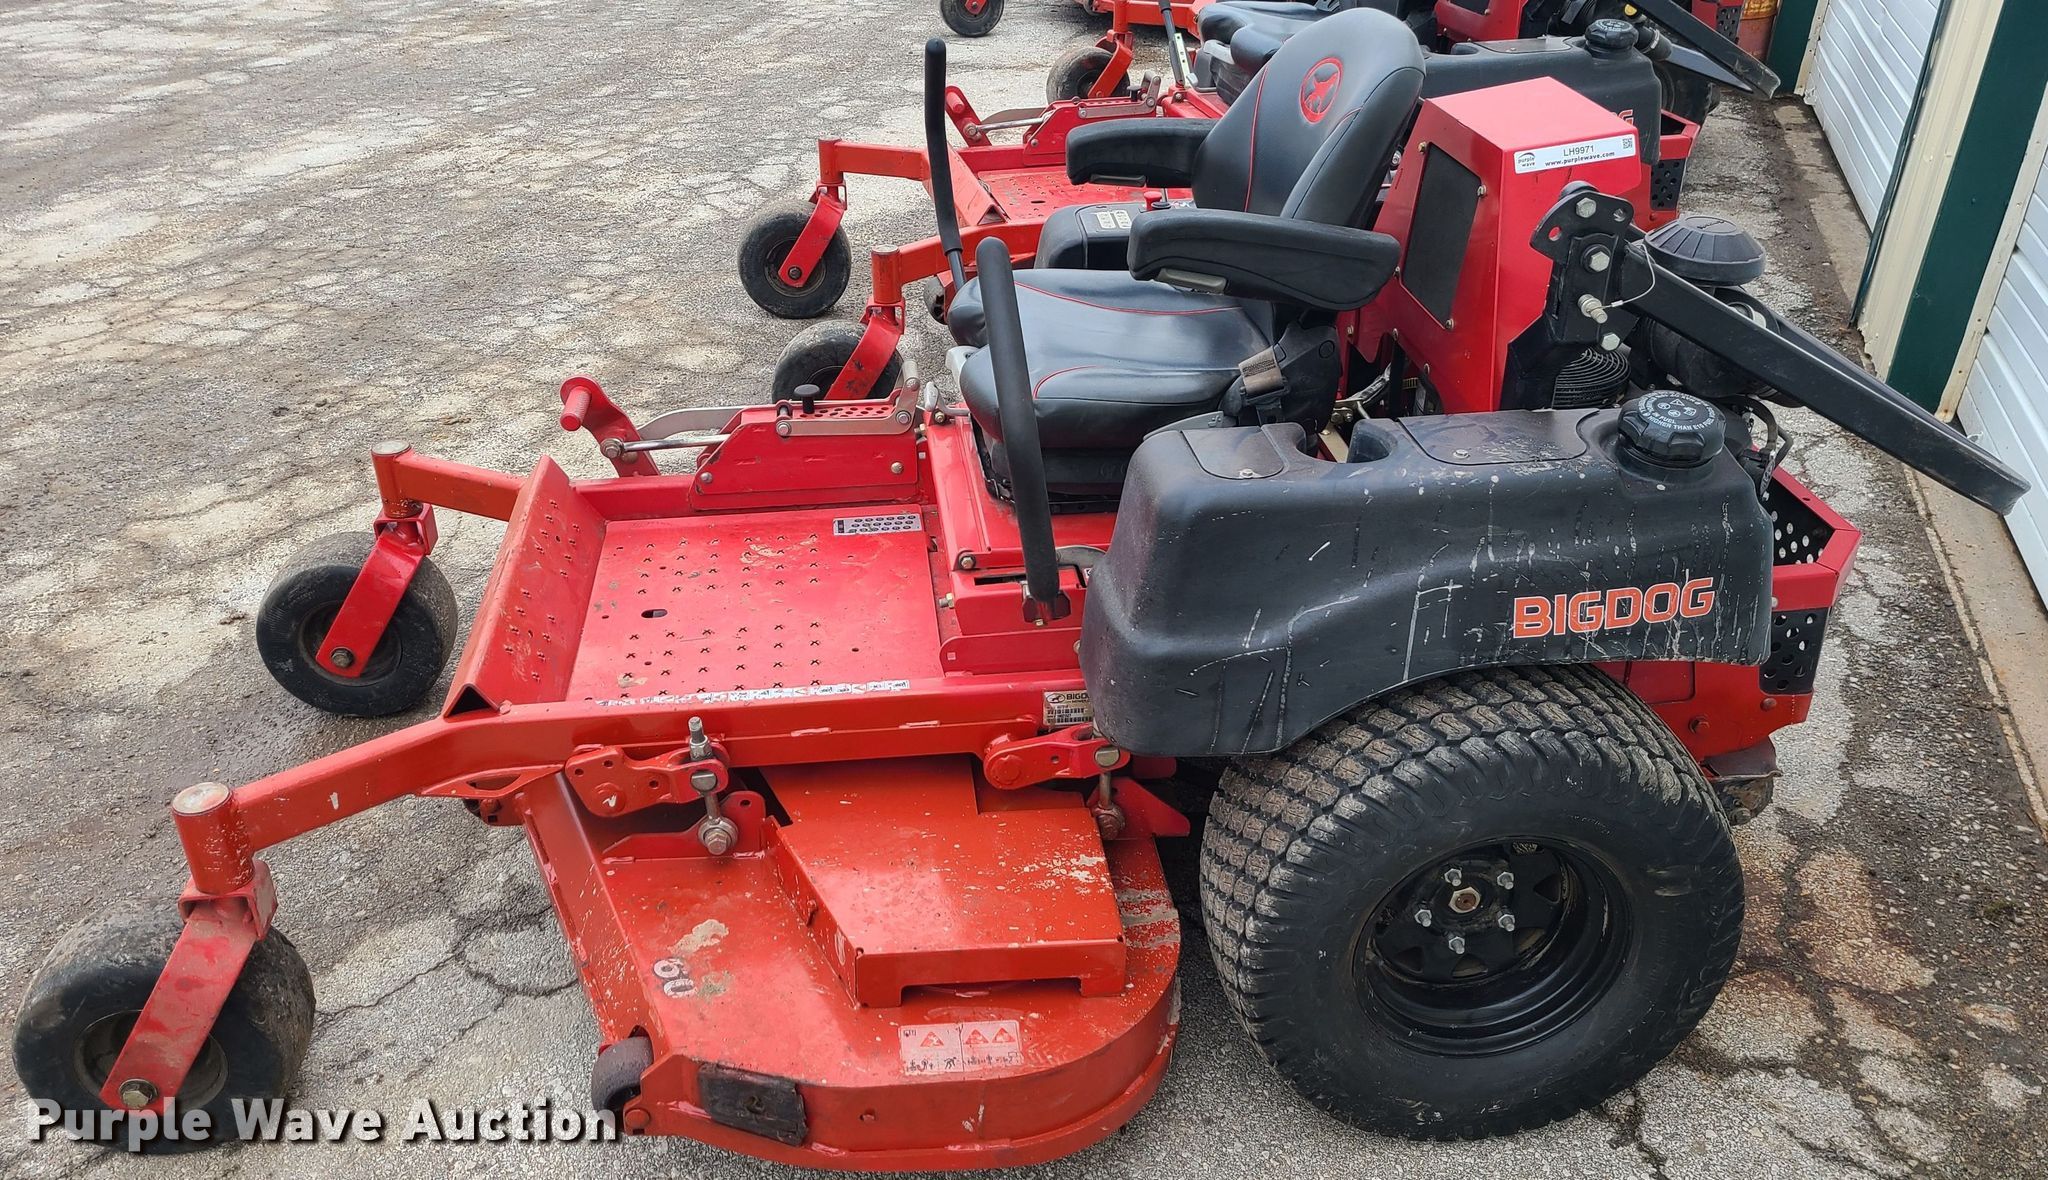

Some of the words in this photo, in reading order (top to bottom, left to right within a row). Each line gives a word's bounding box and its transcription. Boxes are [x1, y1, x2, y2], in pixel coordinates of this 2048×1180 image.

[1544, 151, 1615, 167] www.purplewave.com
[1563, 145, 1595, 157] LH9971
[1513, 576, 1715, 638] BIGDOG
